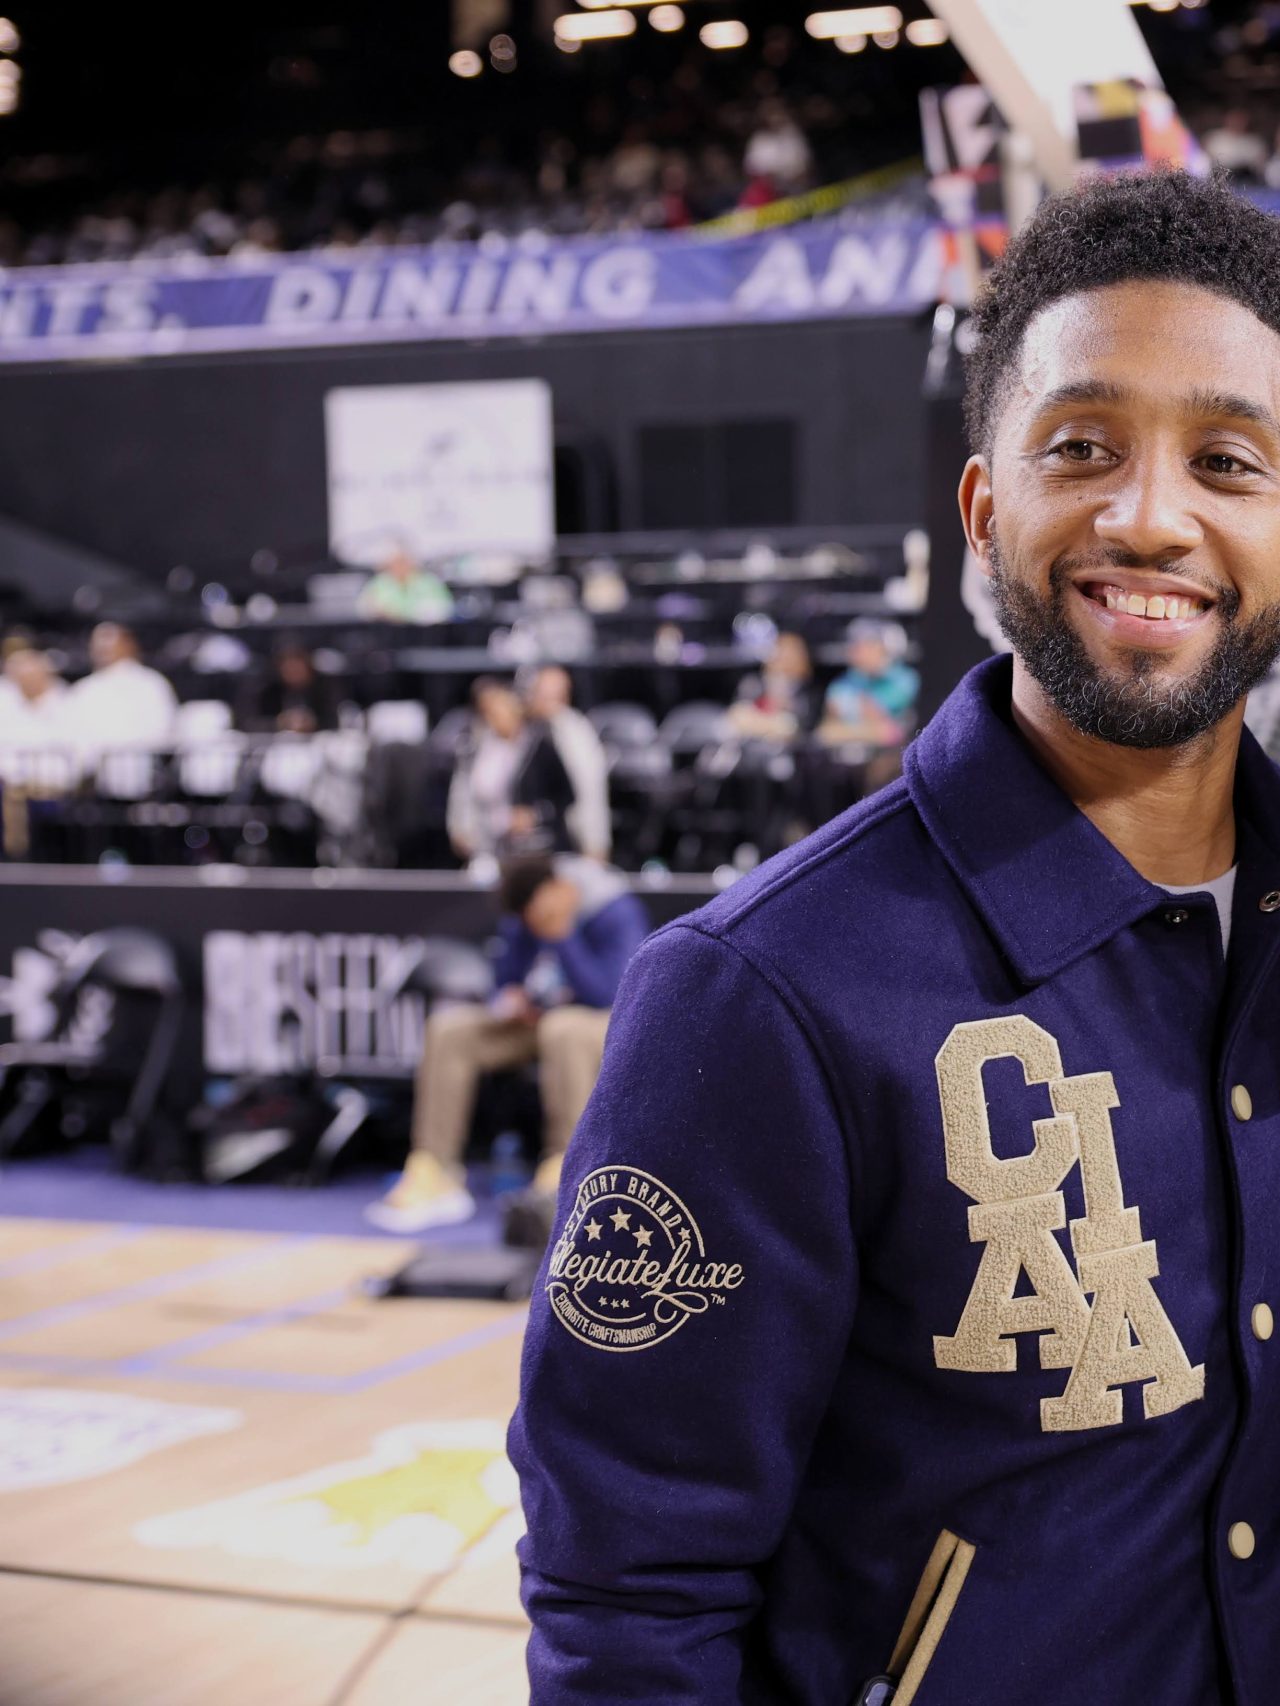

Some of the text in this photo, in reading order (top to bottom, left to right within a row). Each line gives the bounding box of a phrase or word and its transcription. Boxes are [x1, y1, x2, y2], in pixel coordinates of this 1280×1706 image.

[264, 246, 656, 330] DINING
[627, 1176, 682, 1229] BRAND
[555, 1292, 657, 1344] EXQUISITE CRAFTSMANSHIP
